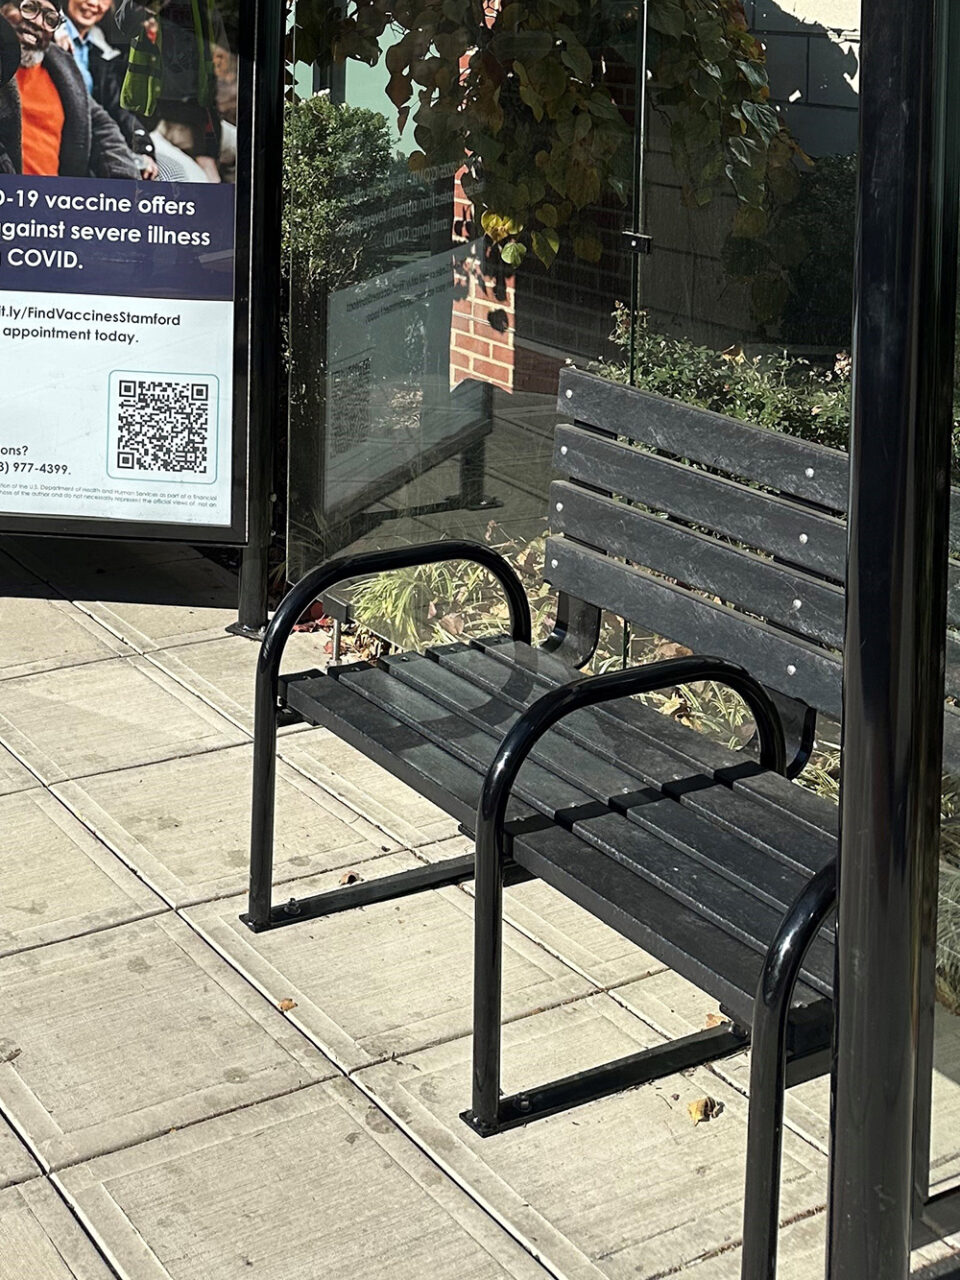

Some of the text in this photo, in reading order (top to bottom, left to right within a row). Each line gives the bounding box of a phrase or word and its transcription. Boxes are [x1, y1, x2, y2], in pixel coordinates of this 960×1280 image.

[44, 192, 131, 212] vaccine
[137, 195, 195, 215] offers
[70, 225, 141, 242] severe
[148, 224, 210, 245] illness
[7, 248, 82, 269] COVID.
[2, 325, 90, 340] appointment
[94, 328, 138, 345] today.
[13, 462, 71, 475] 977-4399.
